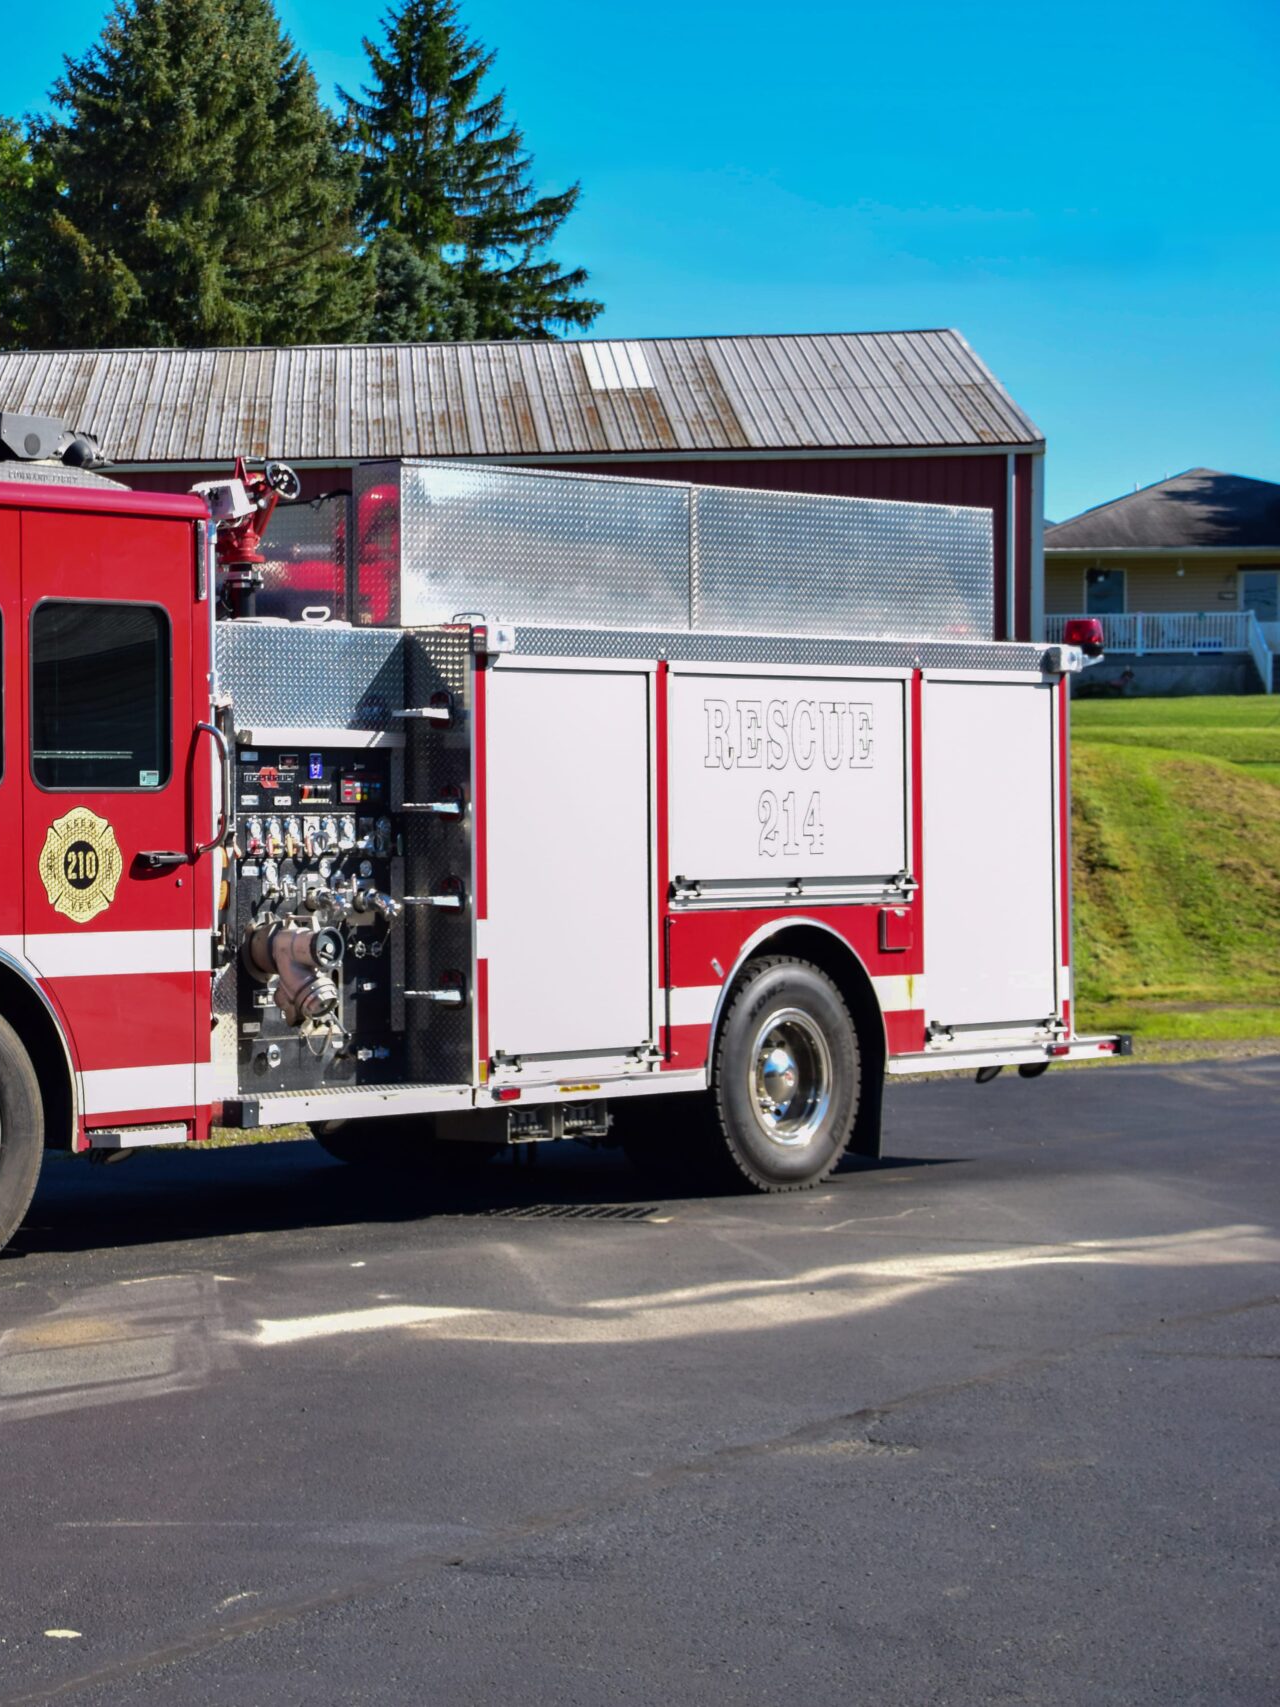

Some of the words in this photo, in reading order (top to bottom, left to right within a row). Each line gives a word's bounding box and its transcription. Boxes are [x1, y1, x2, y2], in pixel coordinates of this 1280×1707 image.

[704, 698, 873, 770] RESCUE
[758, 789, 824, 857] 214
[67, 850, 97, 880] 210
